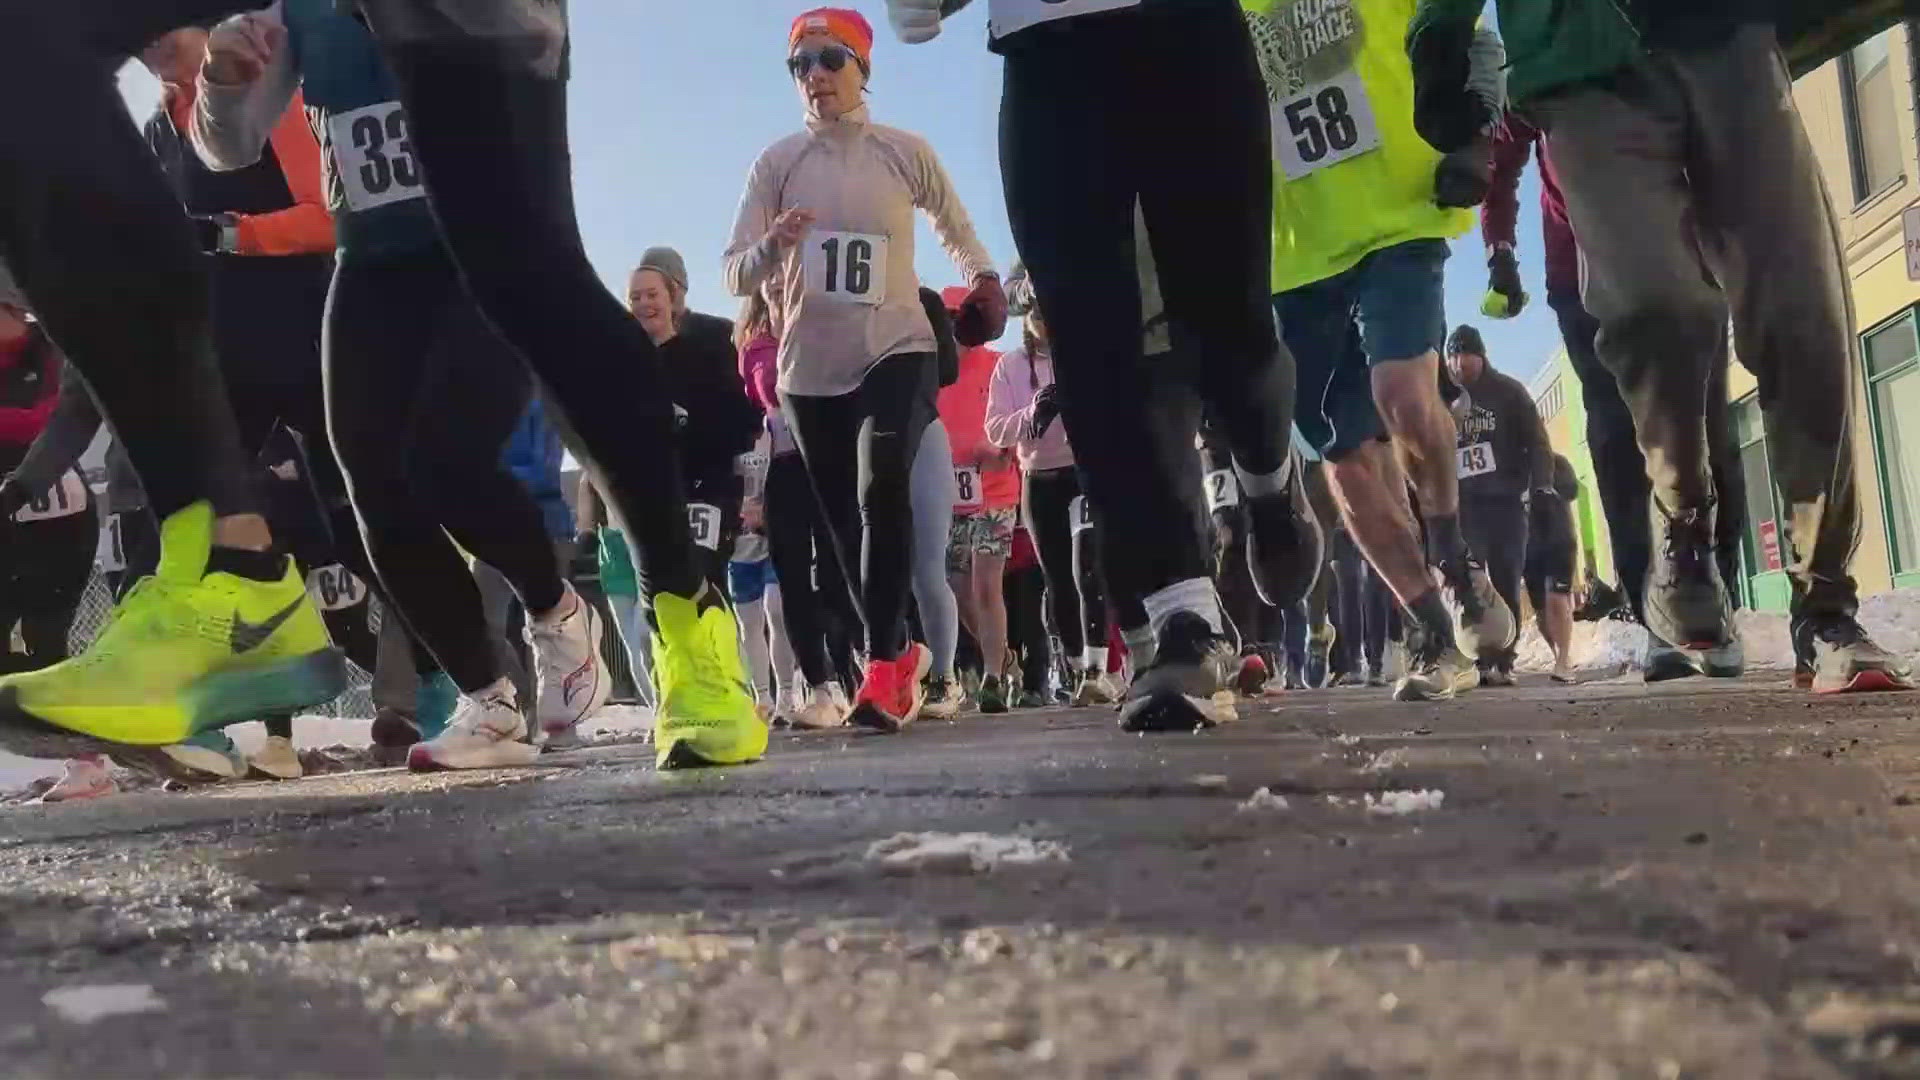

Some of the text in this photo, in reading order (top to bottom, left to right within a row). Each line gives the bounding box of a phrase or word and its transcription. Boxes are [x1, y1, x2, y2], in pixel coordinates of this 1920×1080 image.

[1301, 8, 1354, 58] RACE
[1284, 86, 1358, 162] 58
[821, 237, 872, 294] 16
[1463, 447, 1487, 471] 43
[319, 569, 357, 606] 64
